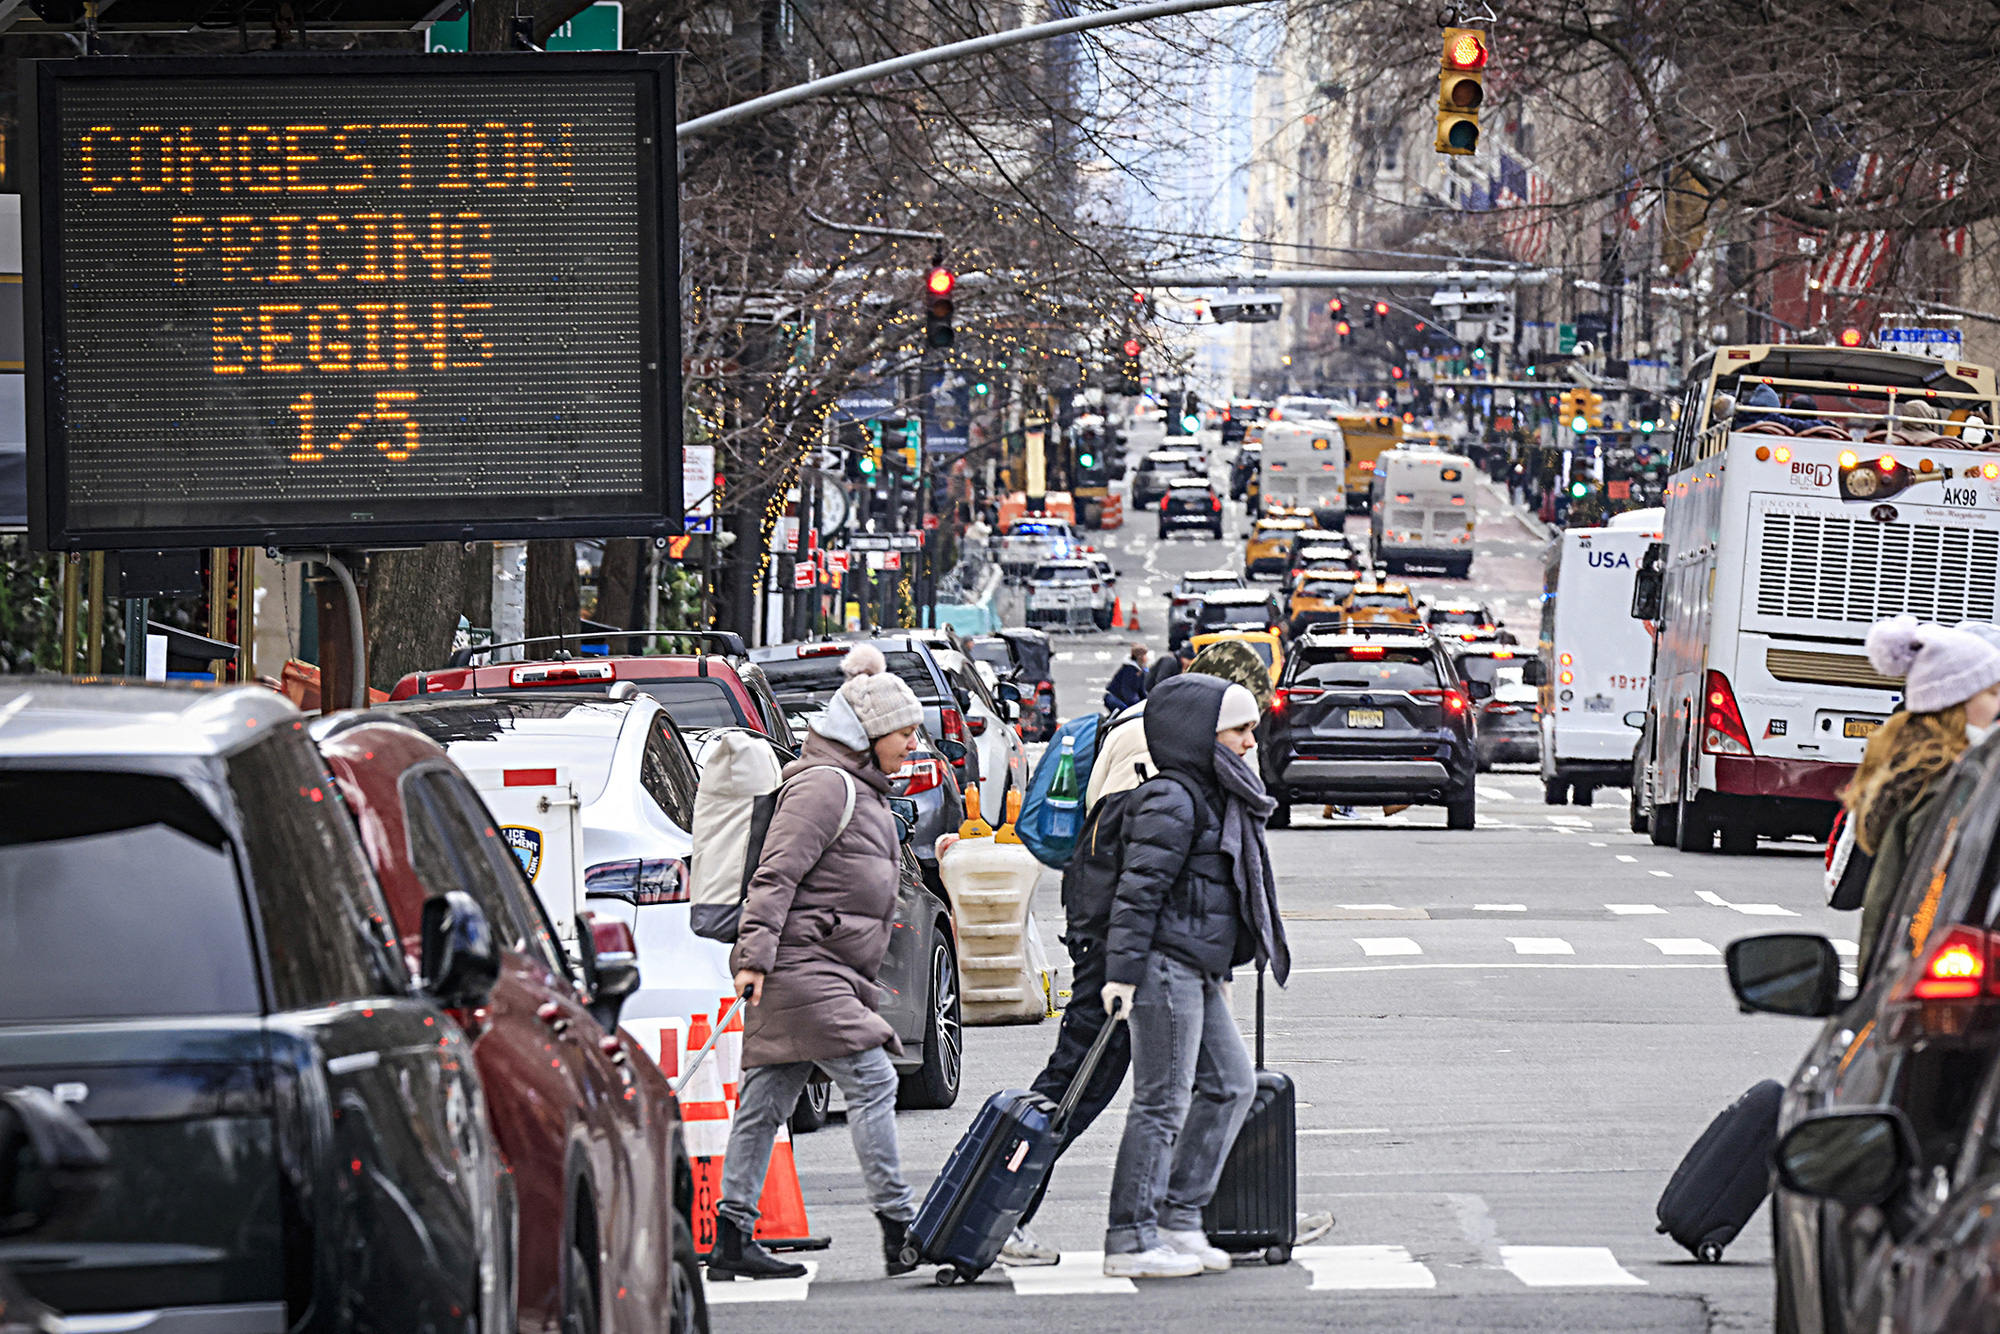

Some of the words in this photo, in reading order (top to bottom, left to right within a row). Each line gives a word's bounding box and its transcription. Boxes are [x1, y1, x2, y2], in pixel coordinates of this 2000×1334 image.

[81, 123, 573, 192] CONGESTION
[171, 213, 493, 283] PRICING
[212, 302, 493, 373] BEGINS
[290, 391, 419, 461] 1/5
[1790, 474, 1813, 487] BUS
[1791, 462, 1814, 475] BIG
[1943, 487, 1977, 506] AK98
[1588, 551, 1631, 569] USA
